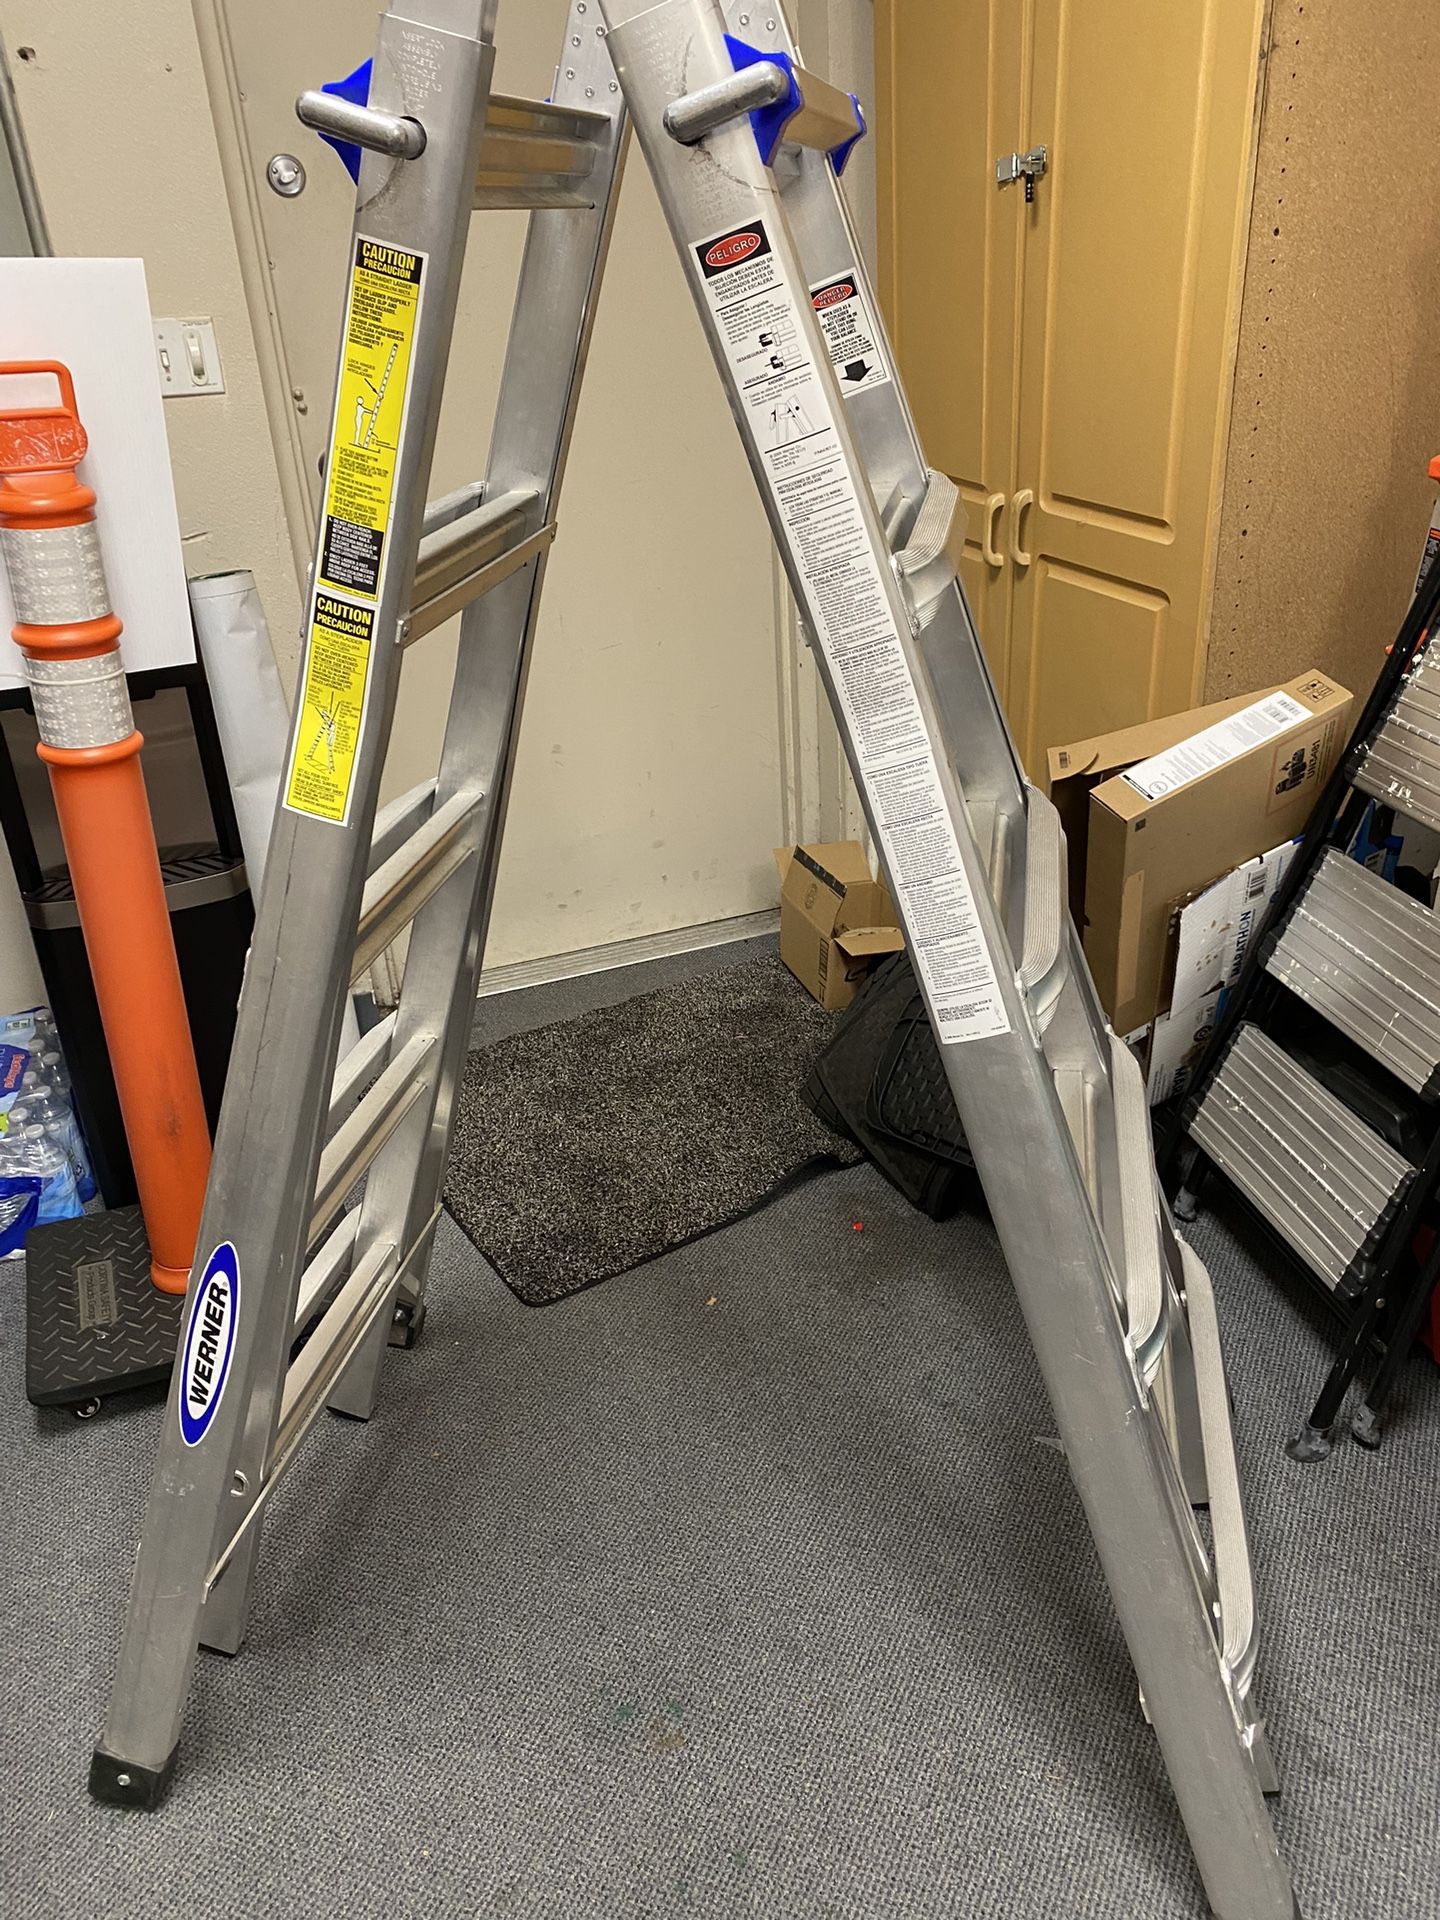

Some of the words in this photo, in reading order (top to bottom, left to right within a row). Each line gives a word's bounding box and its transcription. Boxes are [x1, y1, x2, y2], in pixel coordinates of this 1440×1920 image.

[362, 242, 416, 271] CAUTION
[709, 237, 756, 262] PELIGRO
[707, 276, 724, 287] TODOS
[723, 272, 734, 280] LOS
[733, 259, 766, 276] MECANISMOS
[714, 279, 751, 297] ENGANCHADOS
[750, 272, 767, 282] ANTES
[737, 270, 754, 281] DEBEN
[754, 263, 771, 274] ESTAR
[369, 290, 386, 299] LADDER
[393, 280, 412, 290] LADDER
[718, 289, 740, 302] UTILIZAR
[747, 275, 774, 290] ESCALERA
[735, 347, 768, 363] DESASEGURADO
[743, 372, 768, 385] ASEGURADO
[317, 596, 372, 626] CAUTION
[317, 613, 368, 637] PRECAUCIÓN
[330, 631, 363, 645] STEPLADDER
[1305, 738, 1321, 780] UN3481
[1229, 909, 1252, 977] MARATHON
[100, 1296, 111, 1322] SAFETY
[189, 1281, 228, 1406] WERNER
